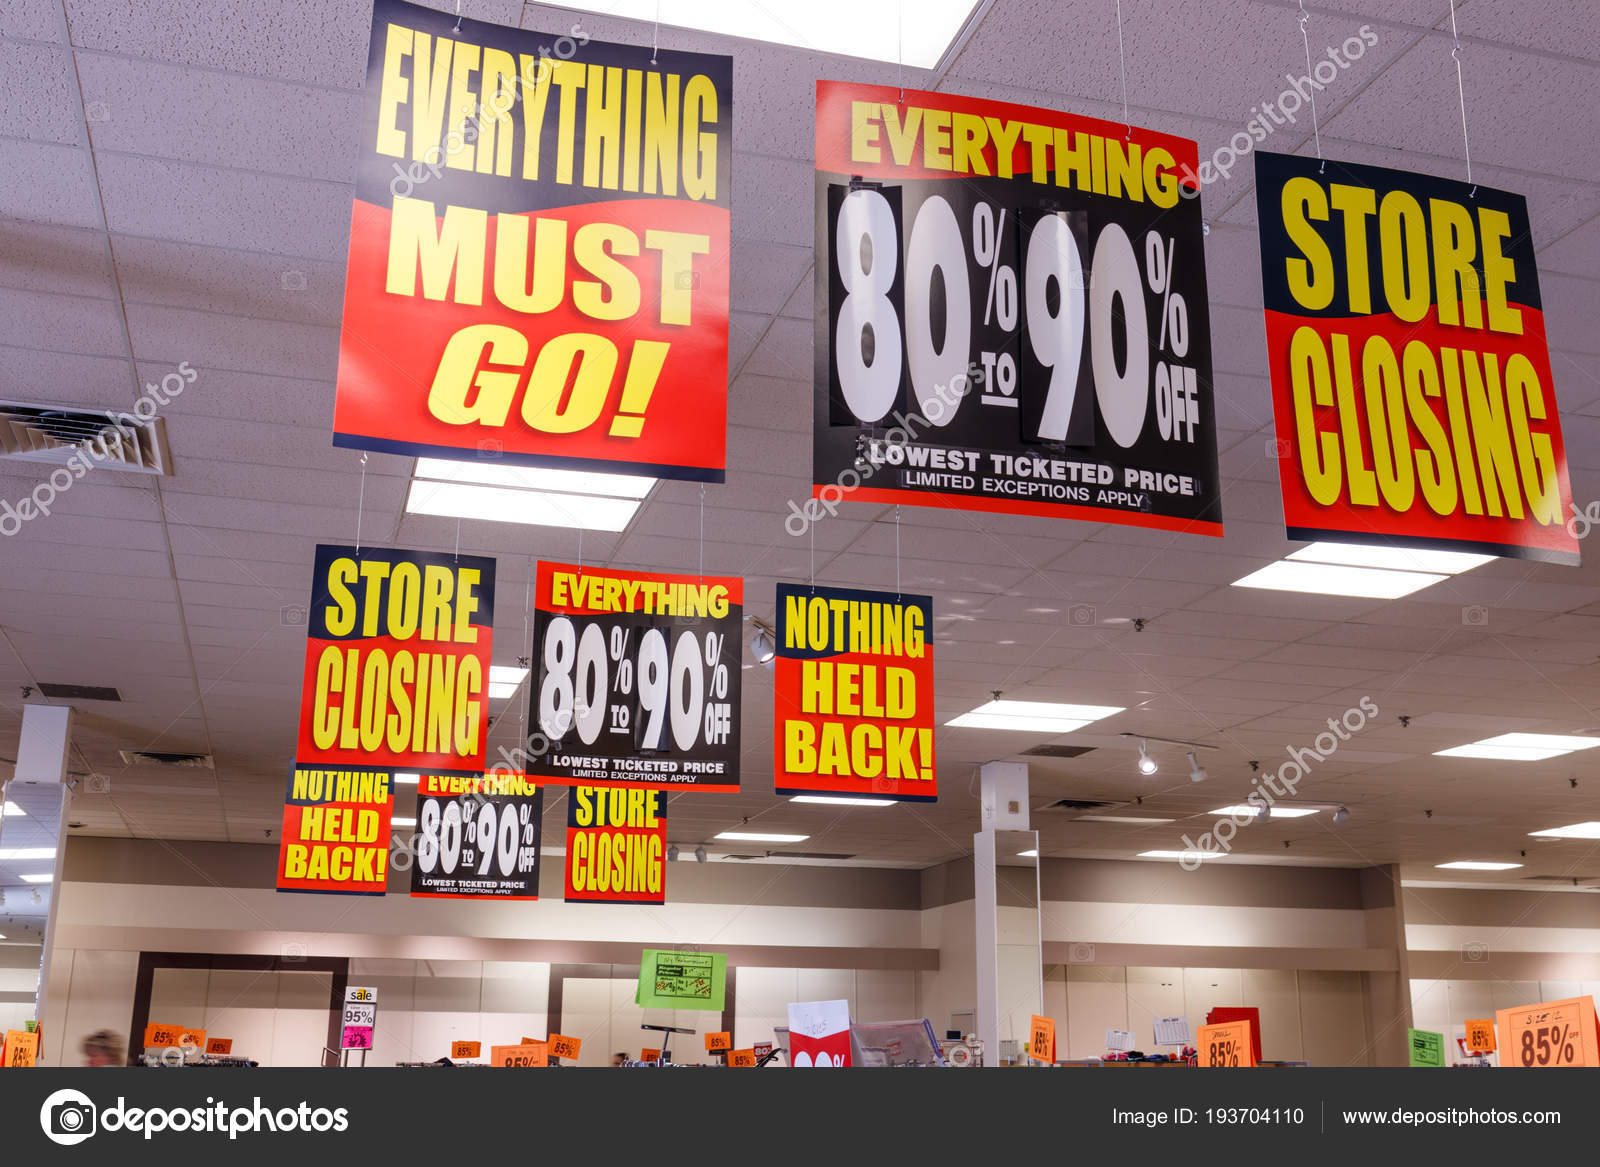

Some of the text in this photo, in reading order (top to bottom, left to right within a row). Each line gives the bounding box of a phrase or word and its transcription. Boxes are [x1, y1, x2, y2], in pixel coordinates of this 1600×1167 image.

[376, 23, 718, 201] EVERYTHING
[851, 101, 1179, 208] EVERYTHING
[386, 195, 710, 326] MUST
[1281, 177, 1523, 335] STORE
[428, 324, 671, 438] GO!
[981, 352, 1017, 397] TO
[1156, 361, 1200, 443] OFF
[1290, 325, 1563, 527] CLOSING
[871, 444, 1194, 496] LOWEST TICKETED PRICE
[906, 471, 1143, 508] LIMITED EXCEPTIONS APPLY
[325, 557, 481, 644] STORE
[552, 572, 729, 619] EVERYTHING
[785, 595, 925, 659] NOTHING
[313, 645, 482, 757] CLOSING
[802, 660, 916, 720] HELD
[610, 705, 630, 728] TO
[705, 703, 731, 745] OFF
[553, 755, 724, 774] LOWEST TICKETED PRICE
[785, 719, 933, 781] BACK!
[292, 770, 389, 804] NOTHING
[428, 774, 536, 796] EVERYTHING
[573, 769, 697, 783] LIMITED EXCEPTIONS APPLY
[300, 807, 379, 843] HELD
[575, 786, 660, 828] STORE
[285, 844, 387, 882] BACK!
[462, 849, 474, 863] TO
[518, 846, 535, 872] OFF
[572, 831, 662, 894] CLOSING
[422, 879, 525, 889] LOWEST TICKETED PRICE
[345, 1010, 373, 1024] 95%
[350, 990, 372, 1001] sale
[553, 1042, 573, 1057] 85%
[1209, 1040, 1239, 1067] 85%
[1521, 1023, 1574, 1067] 85%
